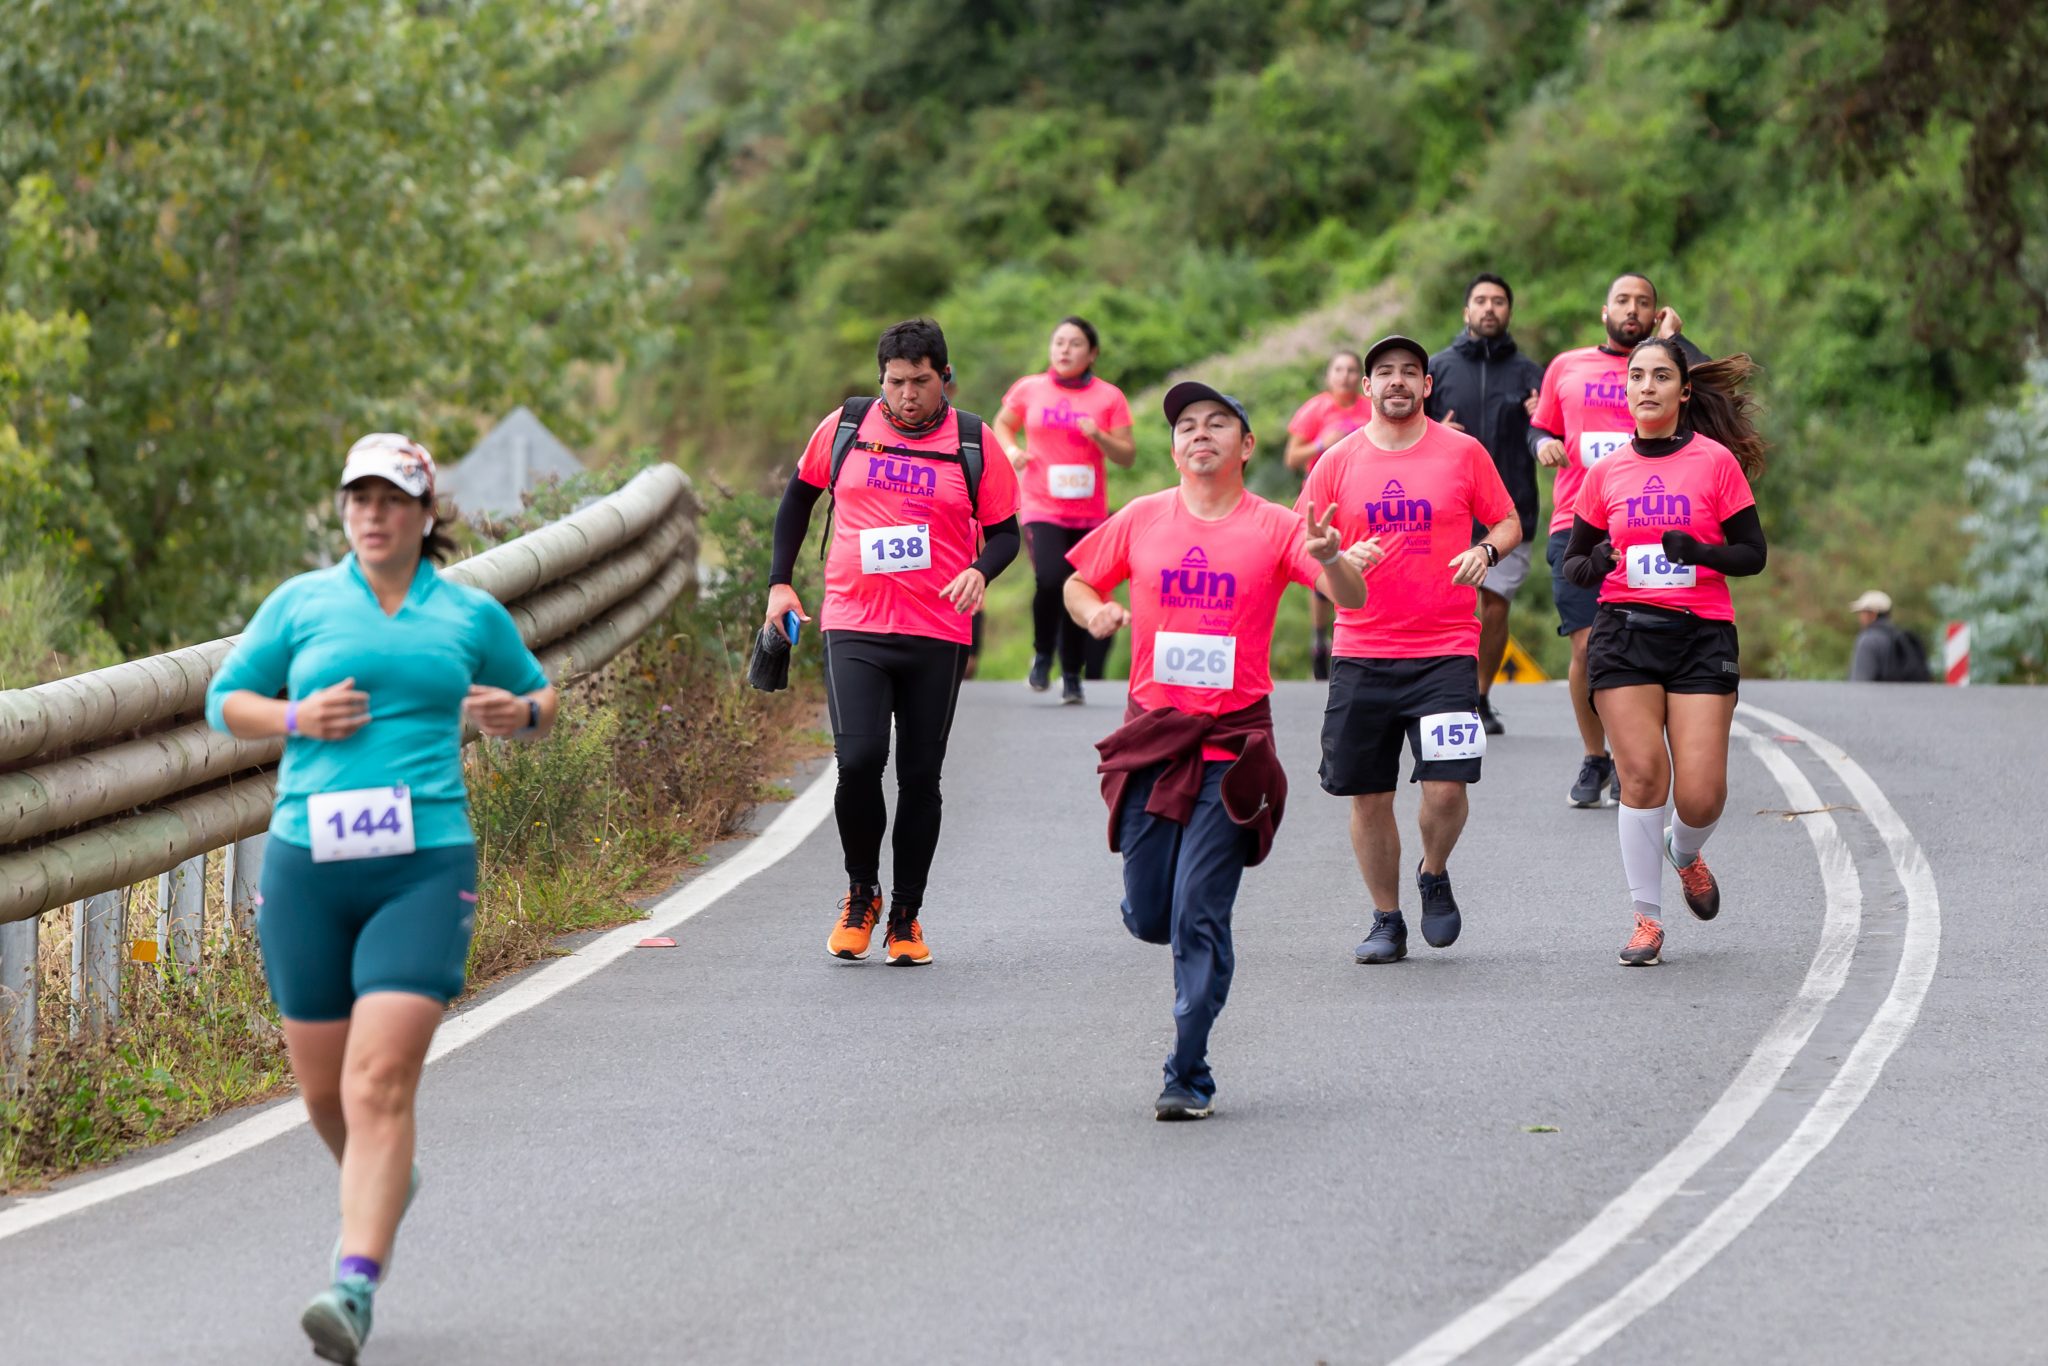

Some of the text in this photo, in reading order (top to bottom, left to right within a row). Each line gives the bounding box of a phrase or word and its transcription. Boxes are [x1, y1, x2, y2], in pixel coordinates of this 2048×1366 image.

[1590, 442, 1626, 459] 13
[868, 457, 937, 488] run
[1057, 474, 1089, 488] 362
[866, 478, 935, 498] FRUTILLAR
[1365, 499, 1432, 524] run
[1626, 494, 1691, 517] run
[1369, 522, 1432, 533] FRUTILLAR
[1627, 515, 1691, 528] FRUTILLAR
[871, 536, 924, 561] 138
[1161, 569, 1236, 598] run
[1161, 596, 1234, 611] FRUTILLAR
[1165, 646, 1227, 673] 026
[1431, 723, 1479, 746] 157
[328, 807, 402, 839] 144
